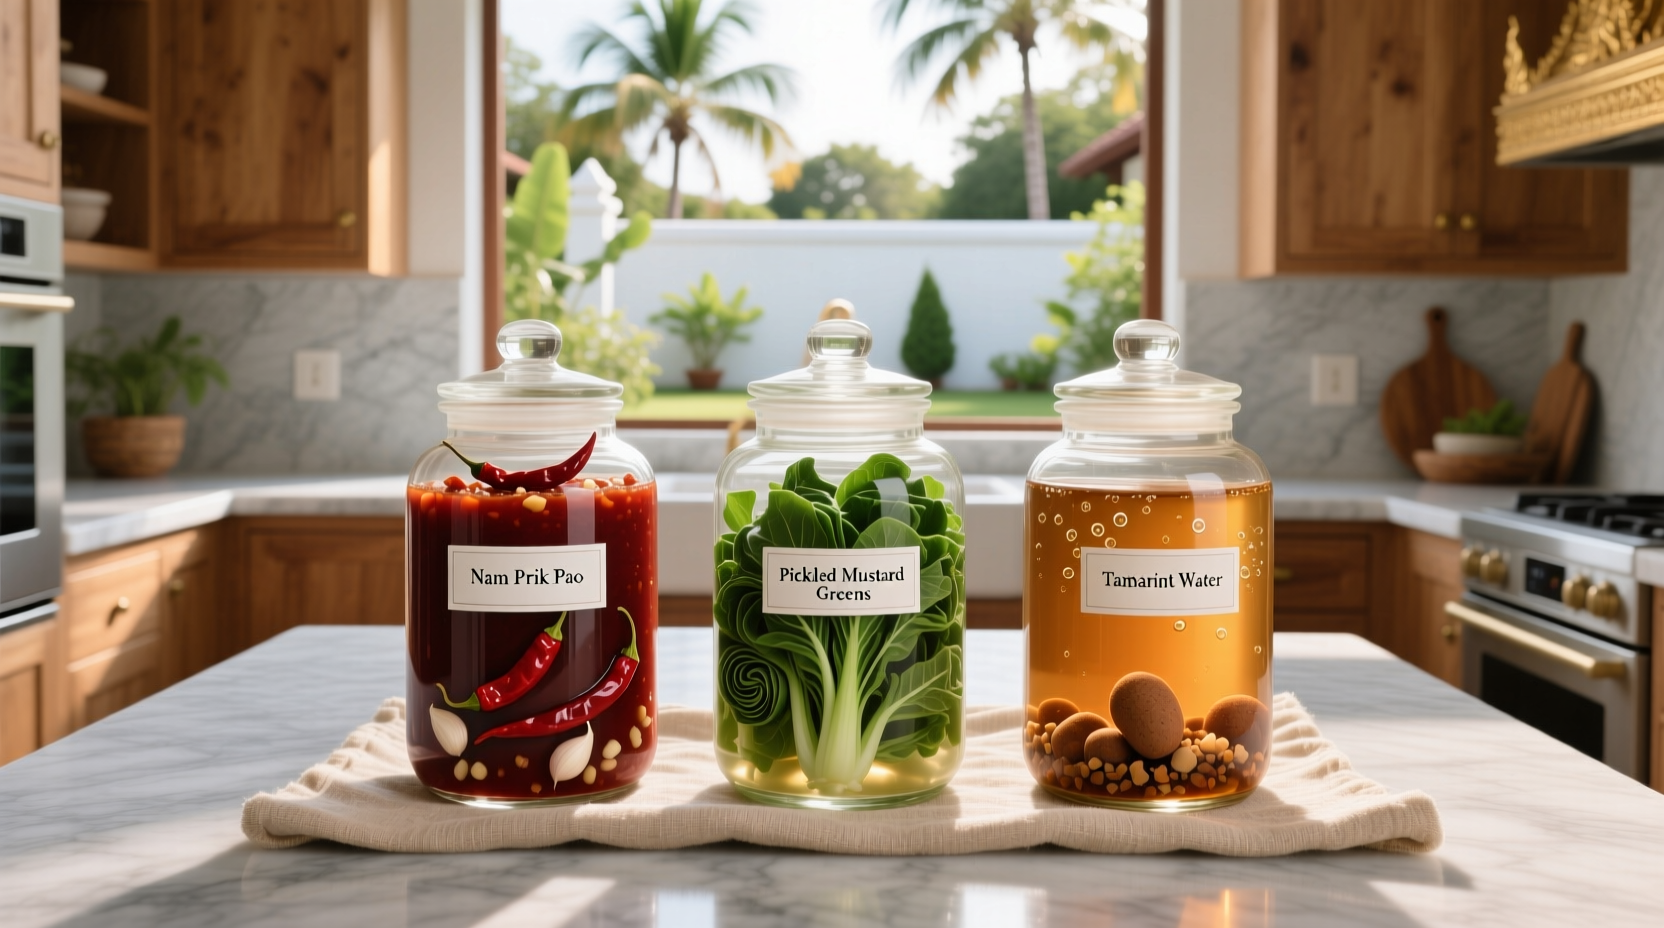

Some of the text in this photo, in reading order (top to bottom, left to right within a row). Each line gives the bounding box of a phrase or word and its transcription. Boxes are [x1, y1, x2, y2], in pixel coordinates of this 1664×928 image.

[471, 567, 584, 585] Nam Prik Pao
[779, 566, 905, 583] Pickled Mustard
[1178, 571, 1223, 588] Water
